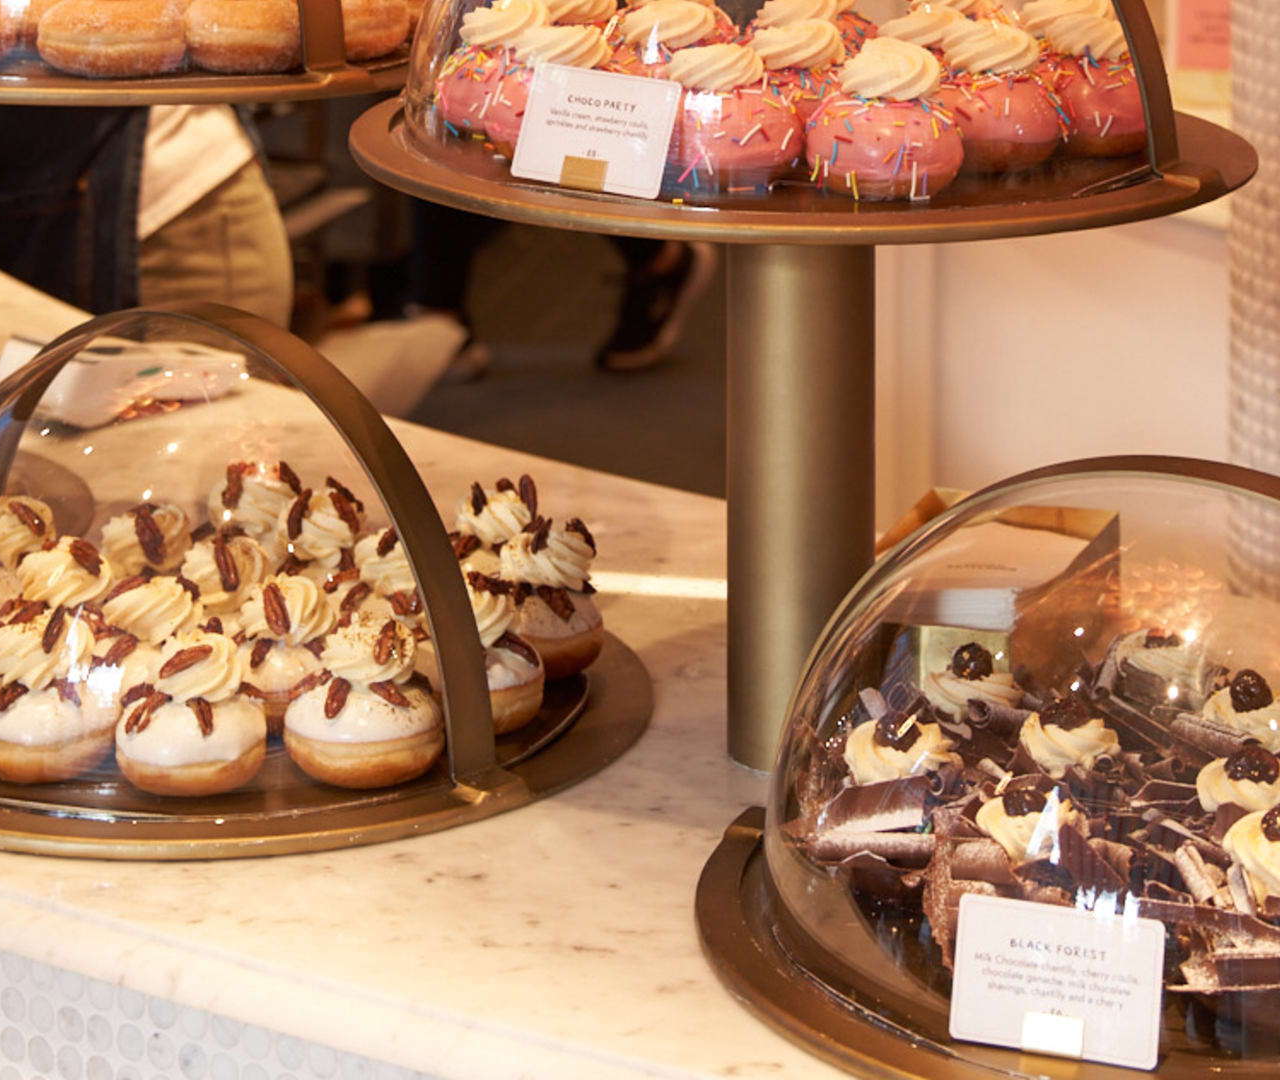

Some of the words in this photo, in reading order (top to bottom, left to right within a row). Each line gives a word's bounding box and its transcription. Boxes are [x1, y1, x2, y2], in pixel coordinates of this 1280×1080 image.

[567, 94, 602, 107] CHOCO
[1009, 937, 1051, 952] BLACK
[1056, 945, 1106, 960] FOREST
[1095, 998, 1123, 1011] chery
